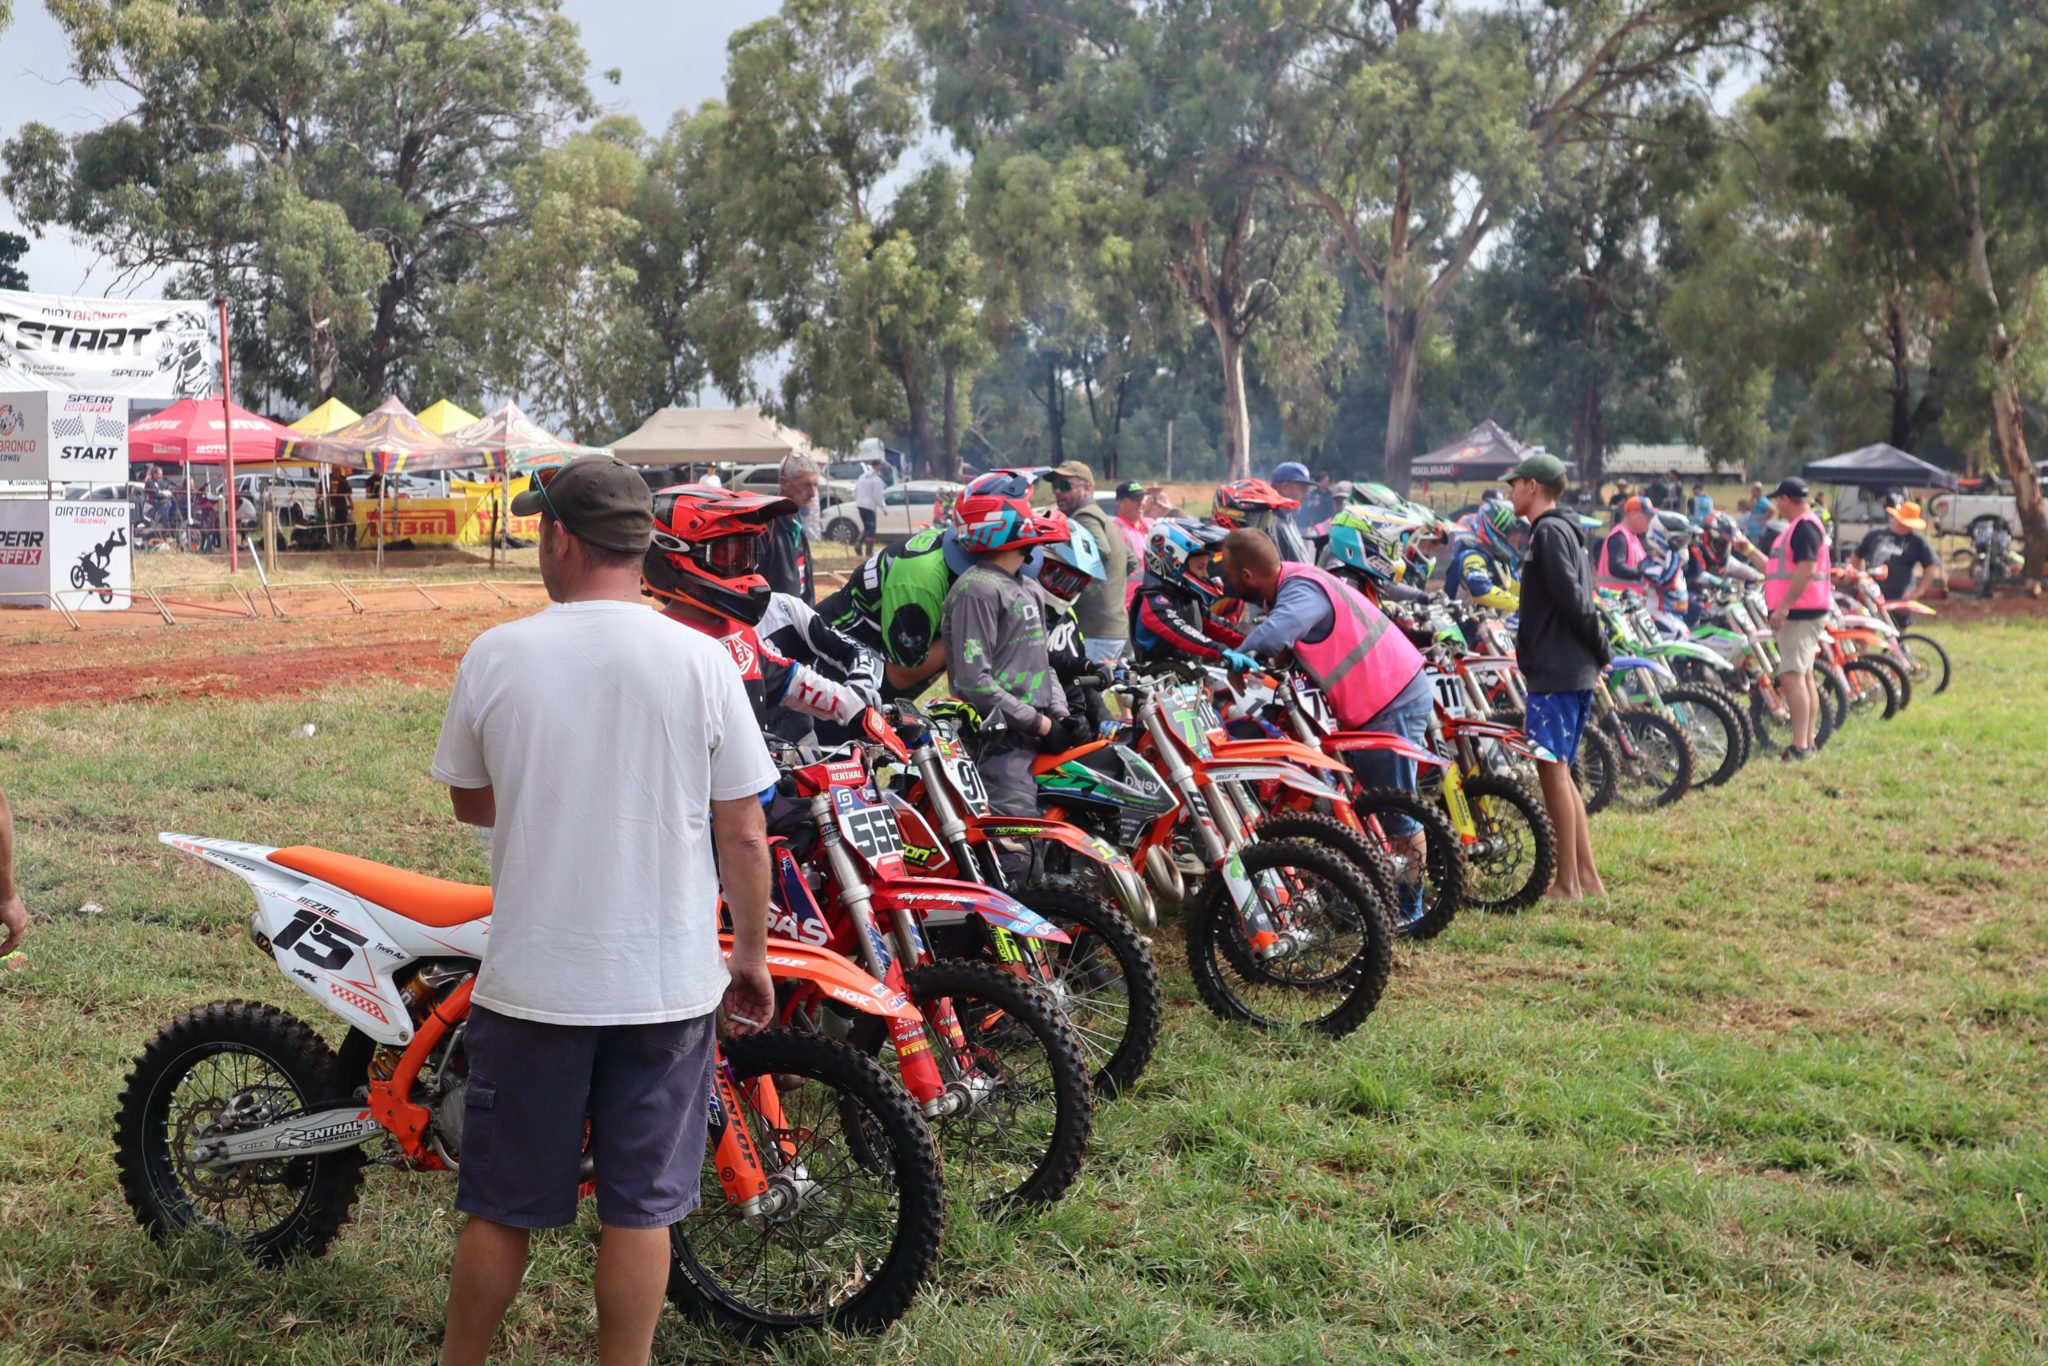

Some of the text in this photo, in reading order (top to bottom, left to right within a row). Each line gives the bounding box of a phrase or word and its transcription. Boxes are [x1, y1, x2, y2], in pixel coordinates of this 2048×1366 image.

[15, 321, 152, 355] START
[110, 369, 154, 377] SPEAR
[67, 394, 114, 404] SPEAR
[60, 446, 118, 460] START
[196, 445, 226, 454] MOTU
[55, 506, 125, 517] DIRTBRONCO
[831, 769, 863, 782] RENTHAL
[957, 761, 986, 801] 91
[848, 809, 904, 858] 555
[207, 851, 255, 872] DUNLOP
[272, 909, 370, 970] 15
[375, 943, 407, 961] Twin Air
[833, 986, 871, 1007] NGK
[716, 1067, 757, 1169] DUNLOP
[276, 1120, 363, 1150] RENTHAL
